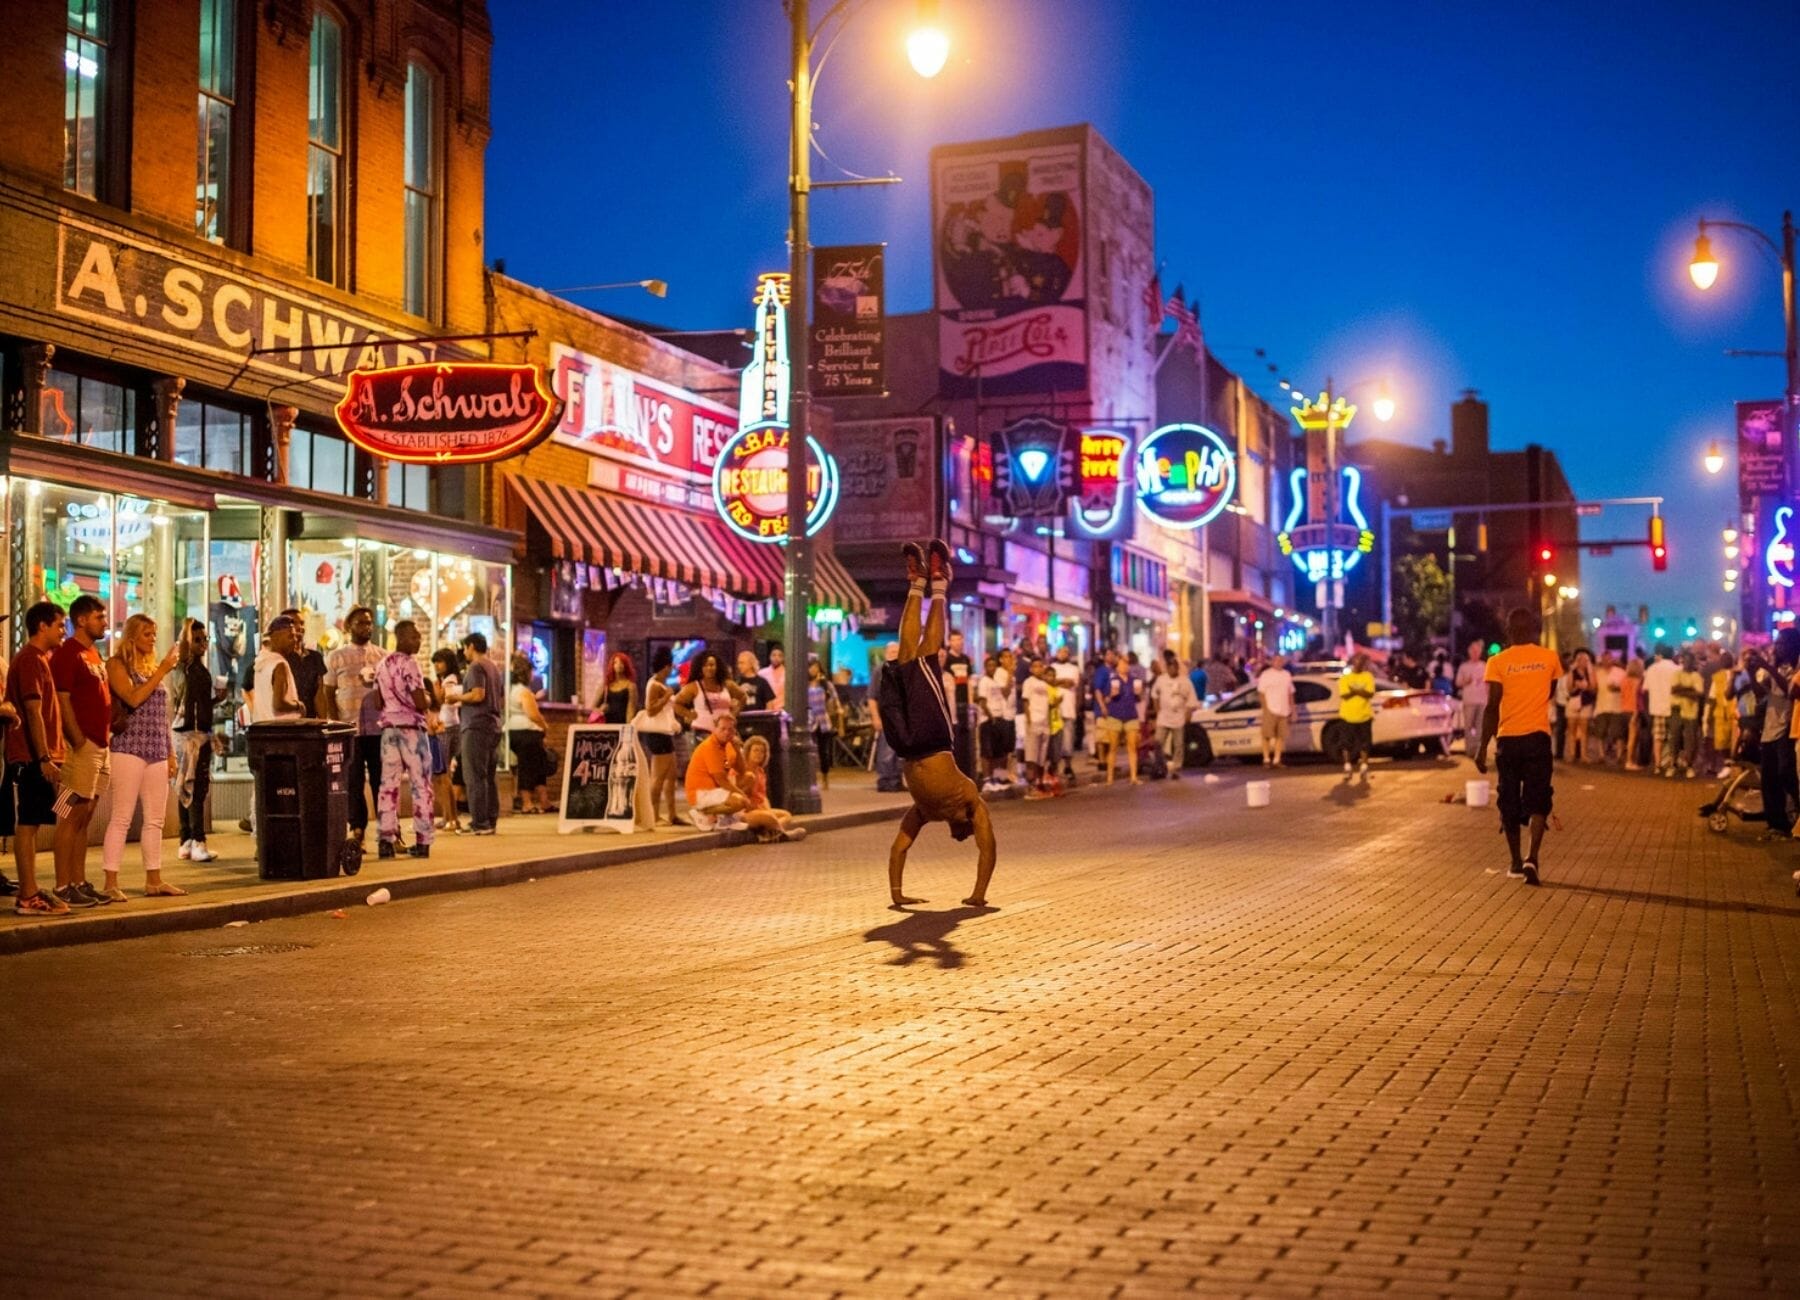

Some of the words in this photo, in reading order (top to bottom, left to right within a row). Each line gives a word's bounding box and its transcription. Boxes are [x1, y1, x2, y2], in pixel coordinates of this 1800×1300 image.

[66, 240, 148, 319] A.
[815, 327, 882, 344] Celebrating
[824, 342, 873, 357] Brilliant
[816, 359, 860, 372] Service
[862, 356, 881, 371] for
[824, 374, 840, 387] 75
[843, 373, 874, 386] Years
[350, 378, 388, 423] A.
[391, 372, 537, 422] Schwab
[566, 367, 675, 455] FN'S
[382, 432, 480, 449] ESTABLISHED
[482, 429, 510, 446] 1876
[720, 465, 821, 496] RESTAURT
[575, 739, 614, 760] HAPPY
[1223, 738, 1252, 747] POLICE
